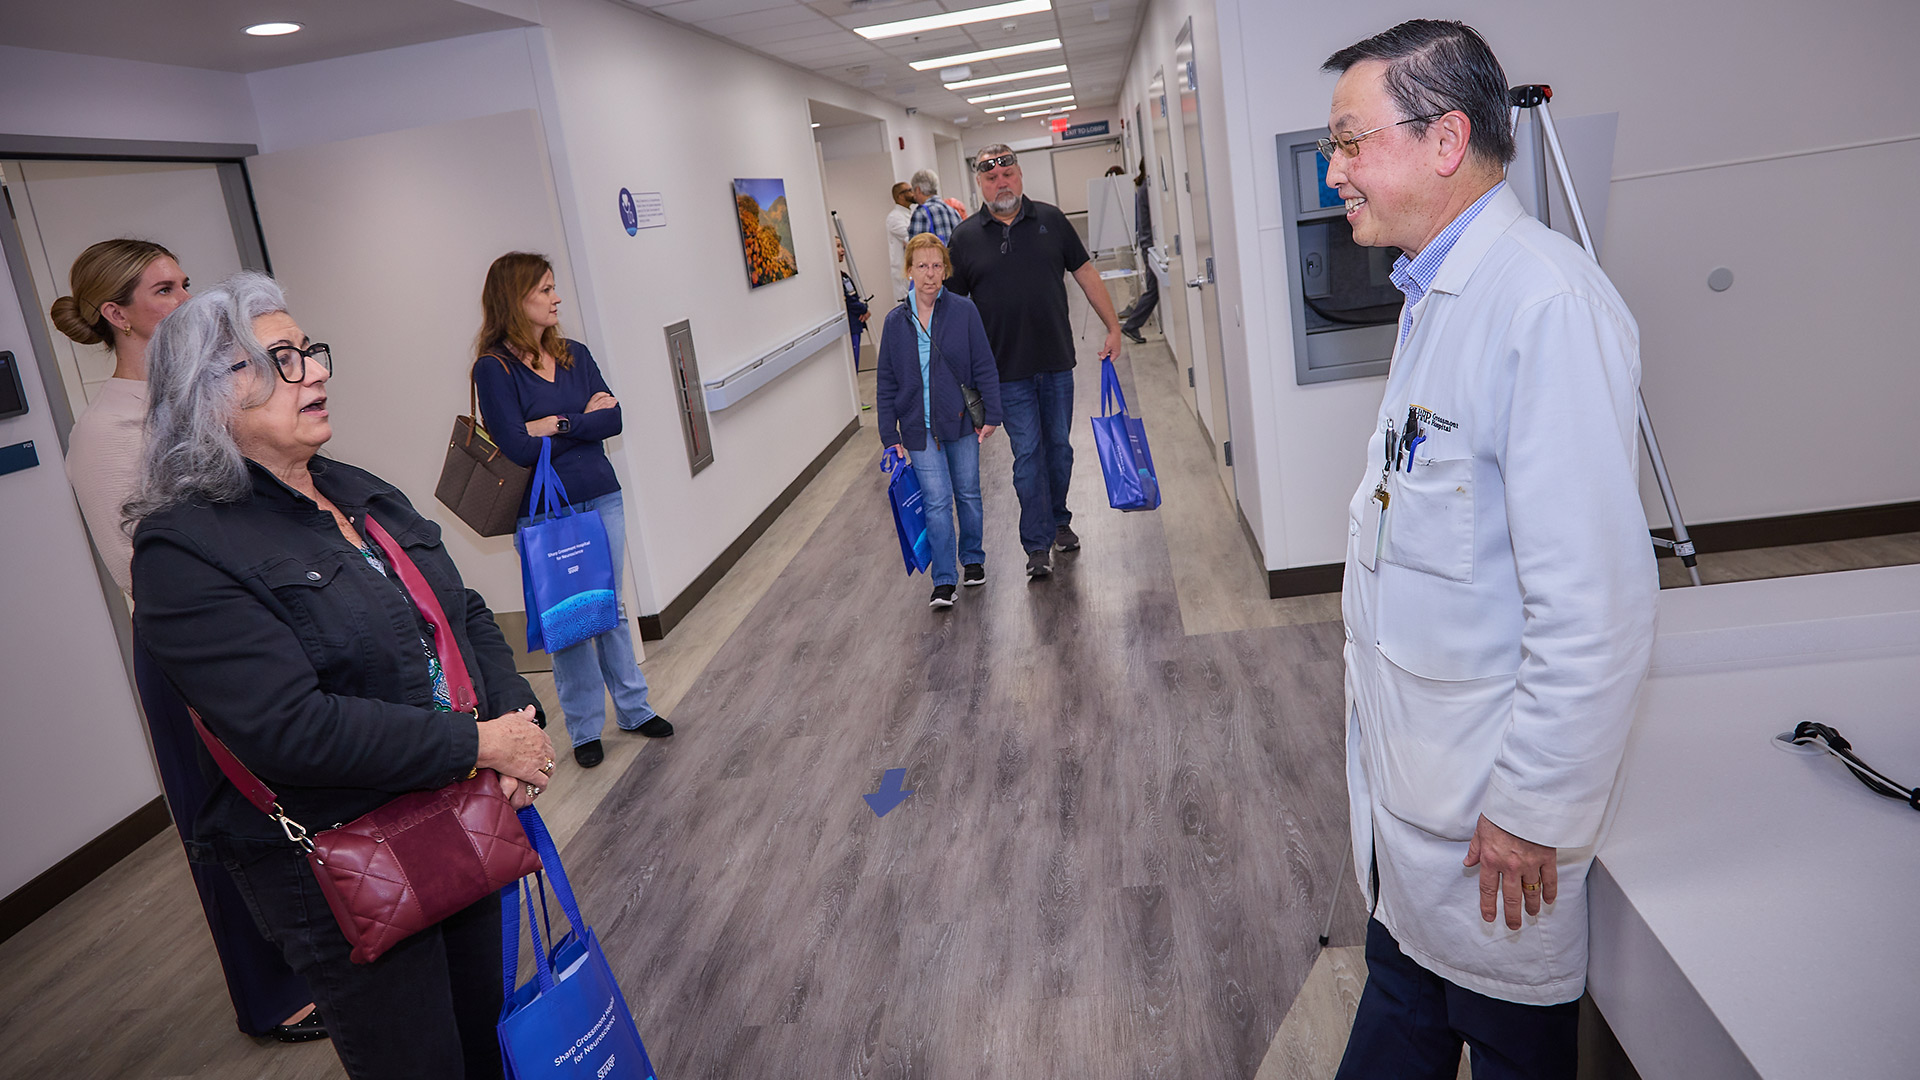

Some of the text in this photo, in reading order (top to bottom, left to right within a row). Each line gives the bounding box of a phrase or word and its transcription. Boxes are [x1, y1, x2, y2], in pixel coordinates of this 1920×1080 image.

[1087, 125, 1106, 133] LOBBY
[562, 550, 583, 559] Neuroscience
[553, 1046, 577, 1067] Sharp
[576, 1014, 607, 1048] Grossmont
[573, 1014, 616, 1065] for Neuroscience
[597, 1054, 616, 1080] SHARP
